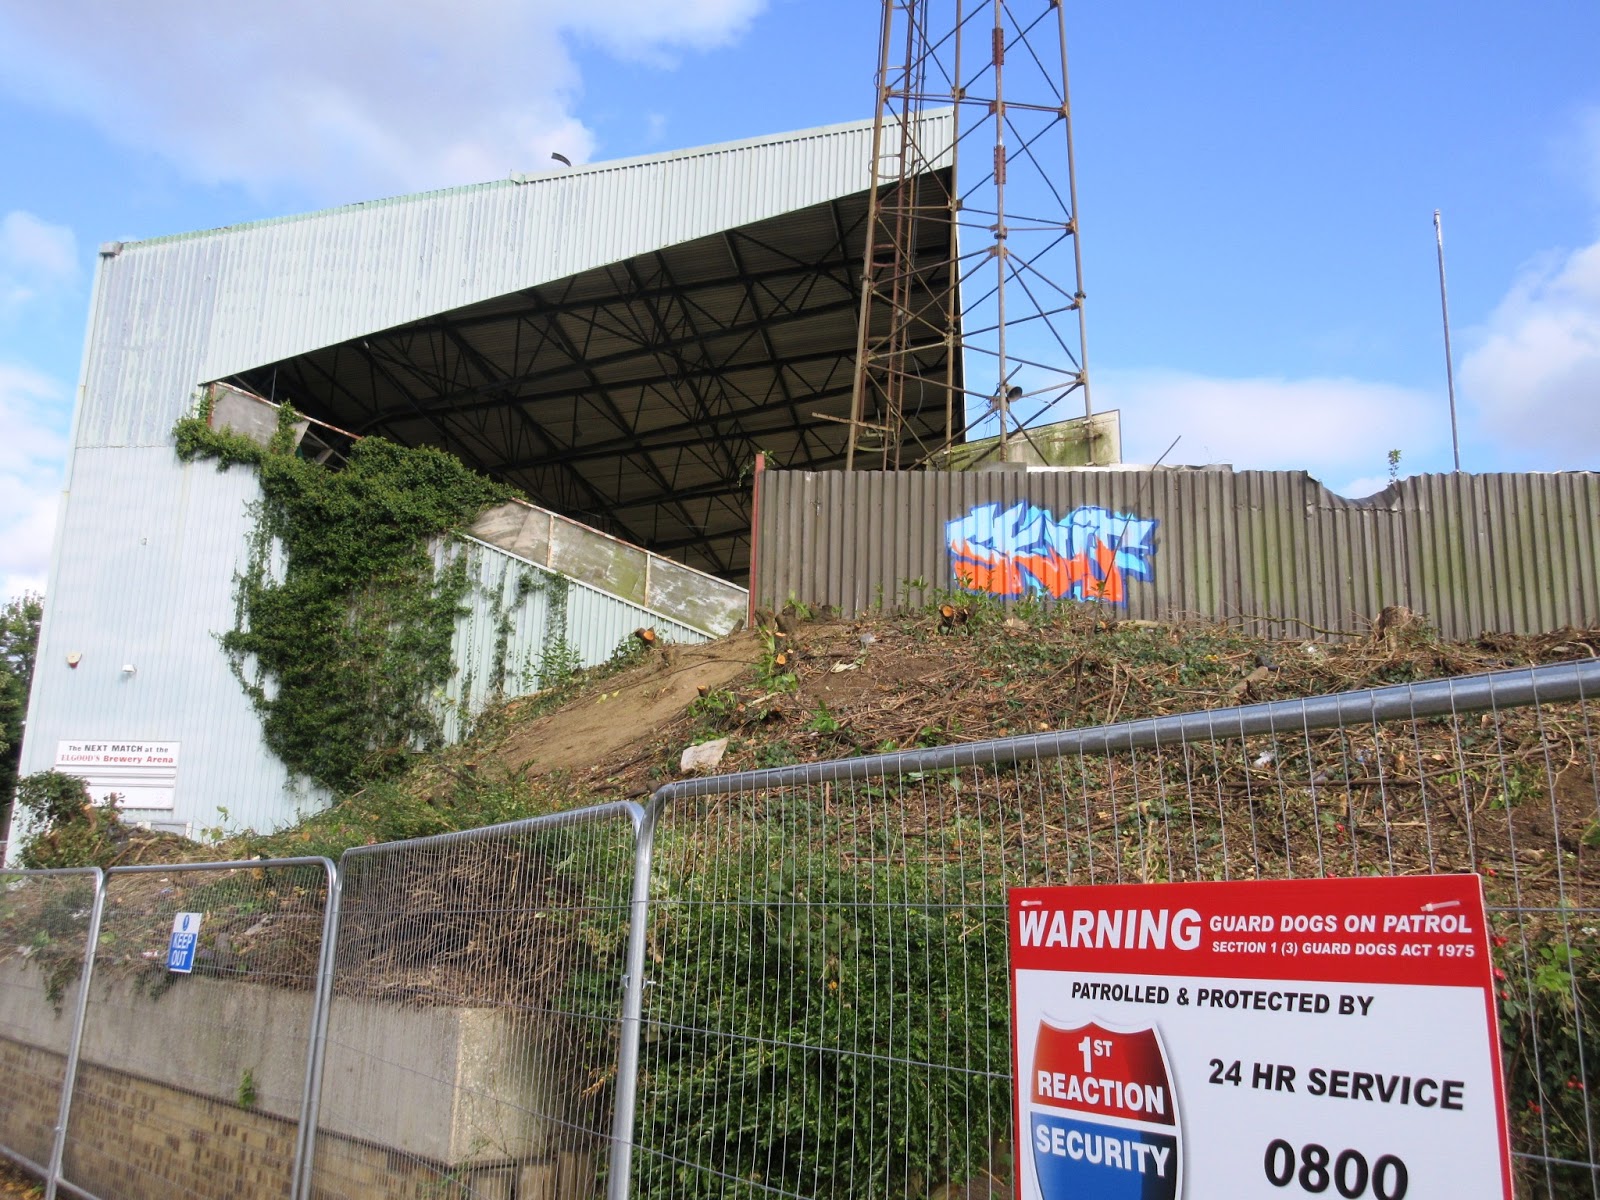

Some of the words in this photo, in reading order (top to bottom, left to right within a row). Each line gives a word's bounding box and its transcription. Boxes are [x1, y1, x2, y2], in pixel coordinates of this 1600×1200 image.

[84, 744, 108, 752] NEXT
[111, 744, 143, 753] MATCH
[103, 755, 143, 764] Brewery
[146, 756, 174, 764] Arena
[173, 933, 193, 949] KEEP
[1019, 908, 1202, 951] WARNING
[1209, 914, 1275, 932] GUARD
[1280, 914, 1338, 933] DOGS
[1344, 914, 1378, 933] ON
[1383, 914, 1473, 934] PATROL
[171, 950, 188, 966] OUT
[1212, 941, 1267, 954] SECTION
[1270, 941, 1278, 954] 1
[1281, 941, 1298, 957] (3)
[1301, 942, 1351, 956] GUARD
[1355, 943, 1397, 957] DOGS
[1401, 944, 1432, 957] ACT
[1436, 944, 1475, 958] 1975
[1071, 982, 1169, 1004] PATROLLED
[1176, 987, 1190, 1005] &
[1197, 988, 1330, 1013] PROTECTED
[1338, 995, 1374, 1016] BY
[1078, 1036, 1112, 1072] 1ST
[1037, 1070, 1165, 1114] REACTION
[1208, 1058, 1242, 1087] 24
[1252, 1063, 1296, 1092] HR
[1307, 1068, 1465, 1110] SERVICE
[1036, 1124, 1170, 1177] SECURITY
[1264, 1138, 1408, 1200] 0800
